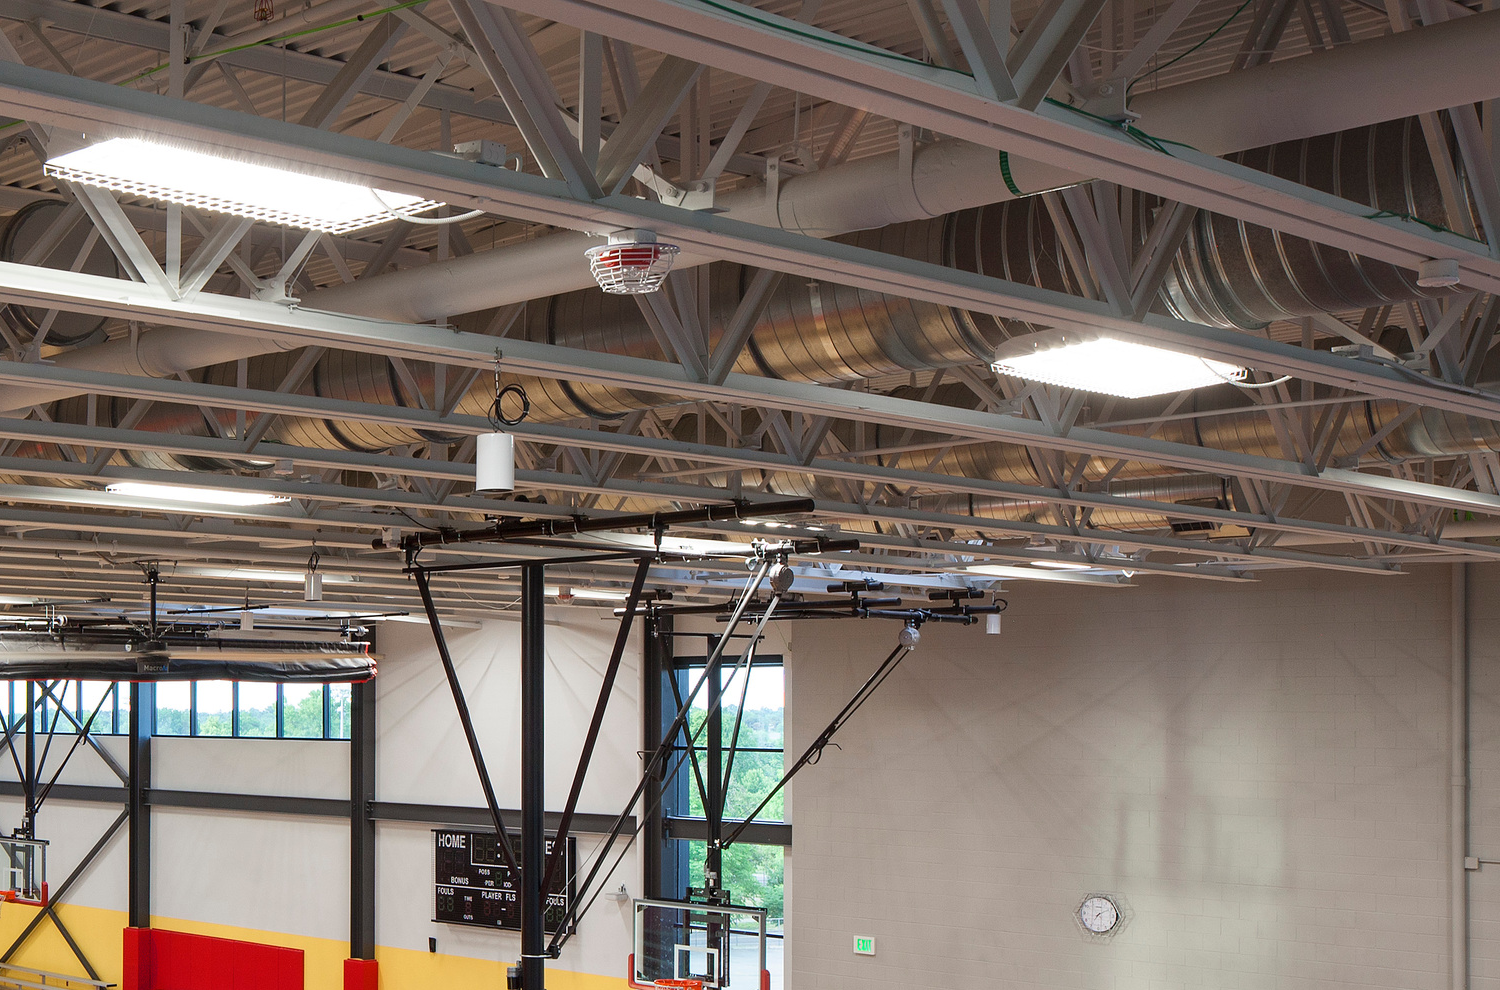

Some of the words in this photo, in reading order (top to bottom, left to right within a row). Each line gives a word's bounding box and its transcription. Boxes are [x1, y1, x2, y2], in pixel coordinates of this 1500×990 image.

[438, 833, 466, 849] HOME
[450, 876, 469, 885] BONUS
[437, 887, 454, 896] FOULS
[481, 891, 502, 900] PLAYER
[505, 893, 516, 902] FLS
[857, 938, 872, 953] EXIT
